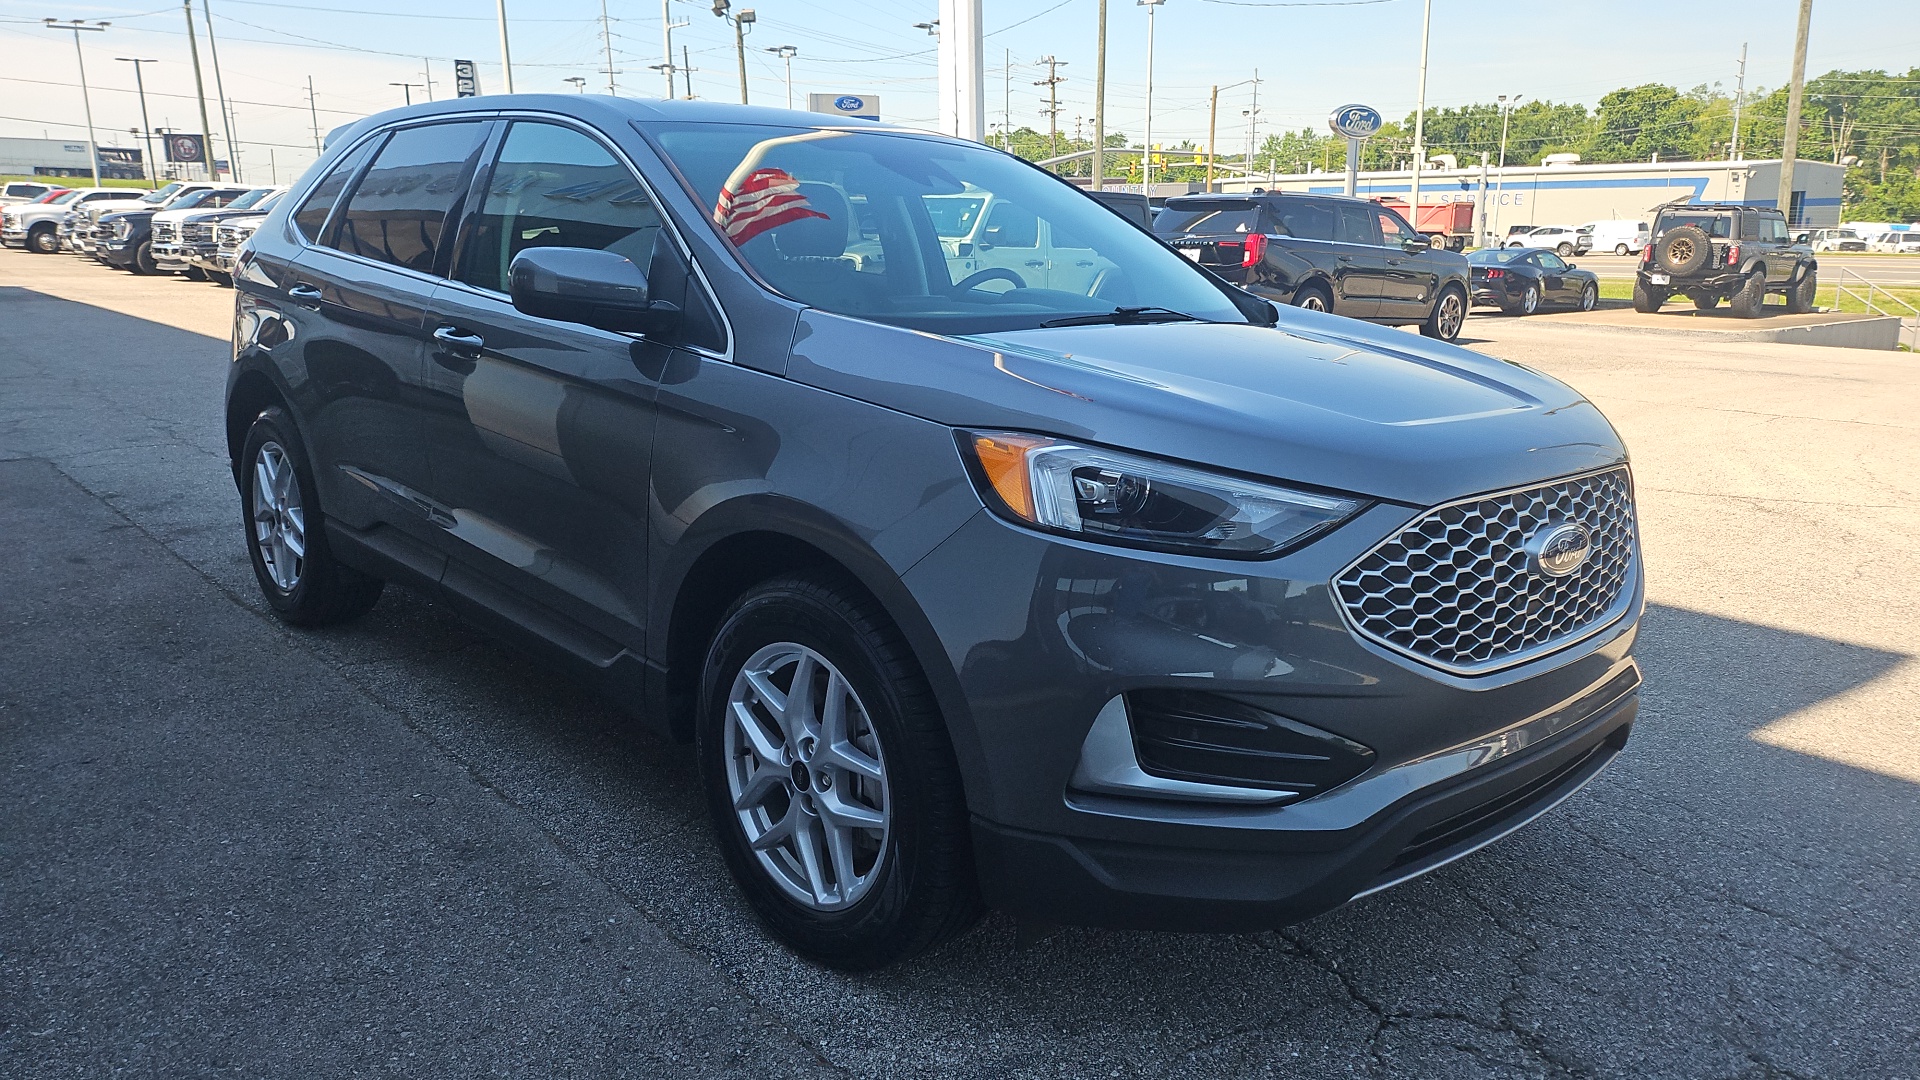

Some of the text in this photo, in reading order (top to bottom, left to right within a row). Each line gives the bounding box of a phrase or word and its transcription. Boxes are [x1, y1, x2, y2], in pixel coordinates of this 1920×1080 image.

[842, 99, 859, 109] Ford
[1346, 110, 1374, 131] Ford
[1101, 184, 1157, 196] OUNTRY
